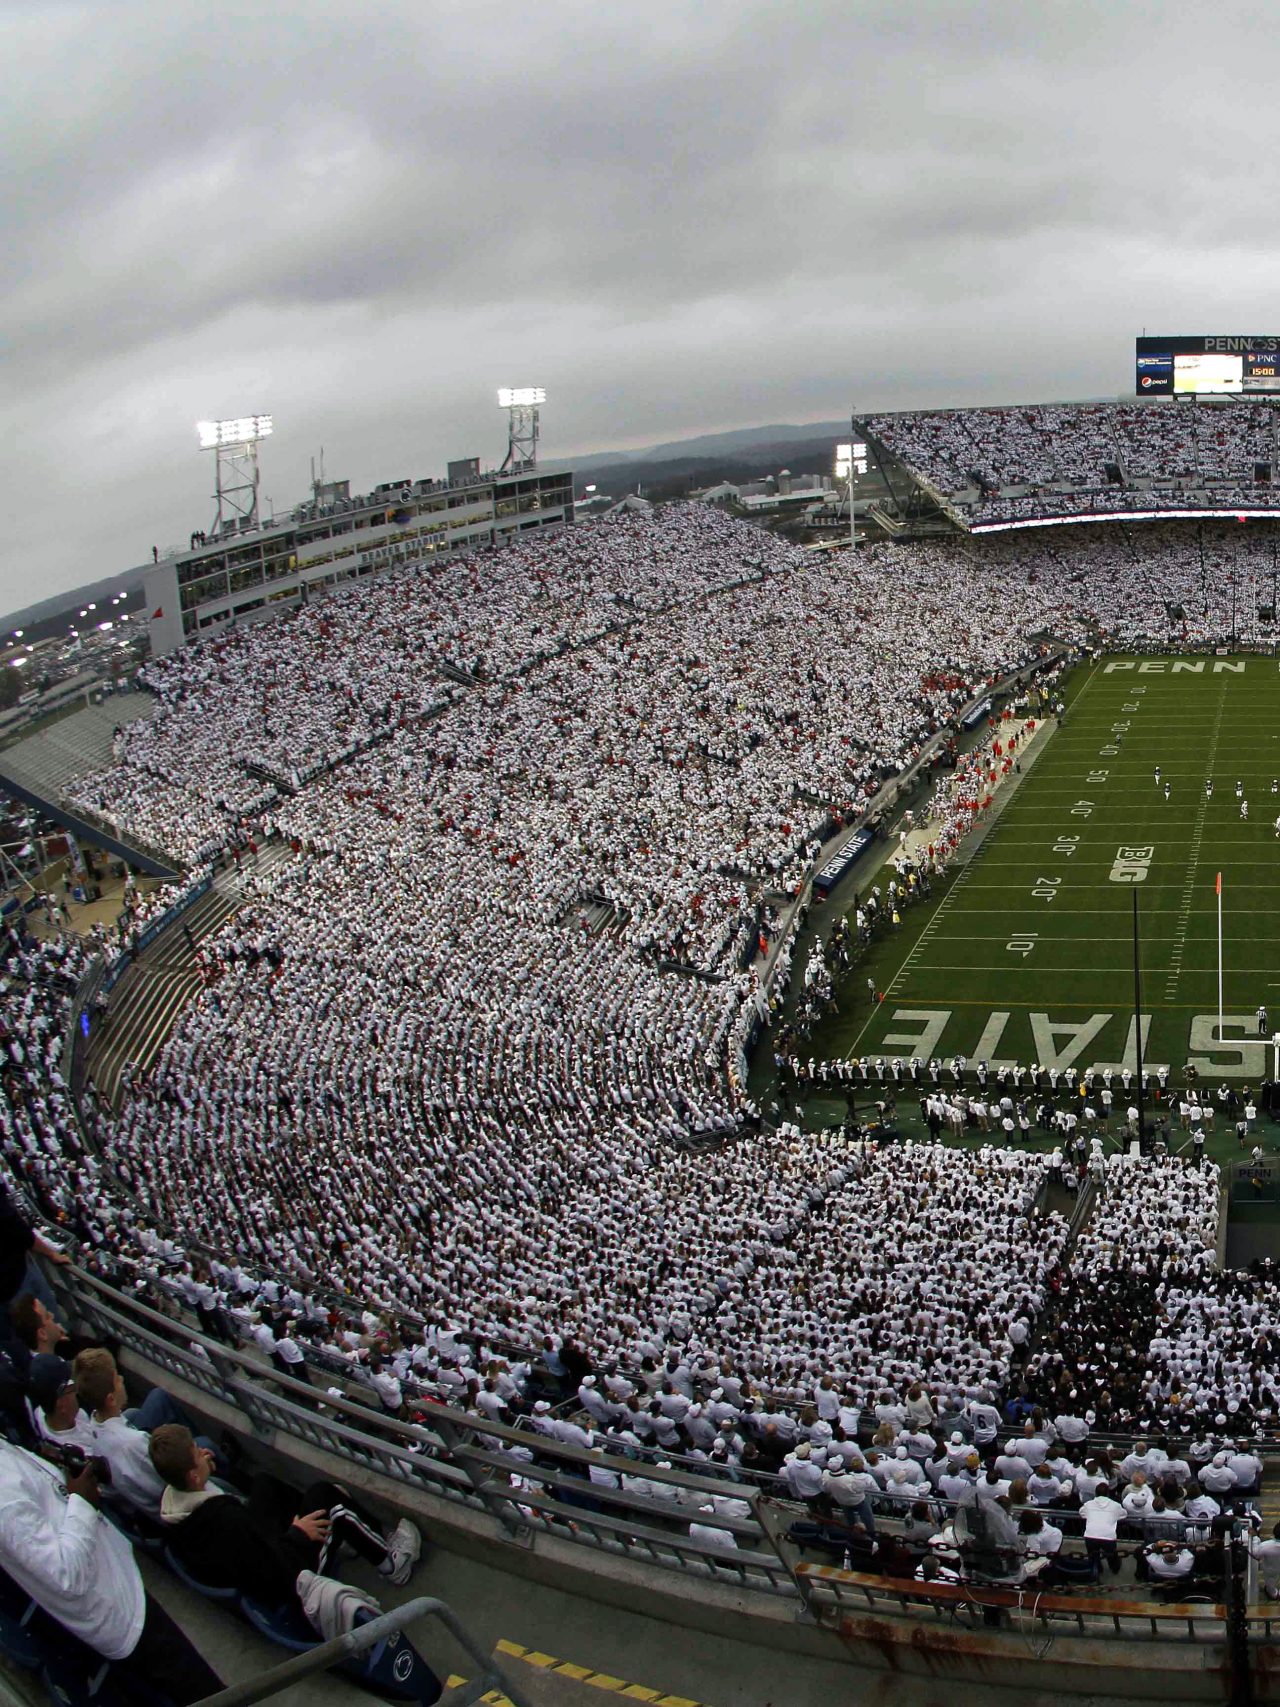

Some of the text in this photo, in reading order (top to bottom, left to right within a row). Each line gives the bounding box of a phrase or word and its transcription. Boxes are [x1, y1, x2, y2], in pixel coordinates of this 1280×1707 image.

[1205, 337, 1251, 350] PENN
[1257, 354, 1277, 363] PNC
[361, 545, 400, 561] BEAVER
[1103, 661, 1247, 674] PENN
[1100, 744, 1120, 756] 40
[1086, 769, 1109, 783] 50
[1070, 800, 1095, 815] 40
[1053, 835, 1081, 852] 30
[820, 835, 867, 879] PENN STATE
[1031, 877, 1062, 897] 20
[1006, 932, 1038, 950] 10
[867, 1009, 1266, 1078] STATE
[1239, 1169, 1271, 1179] PENN
[978, 1413, 987, 1430] 6
